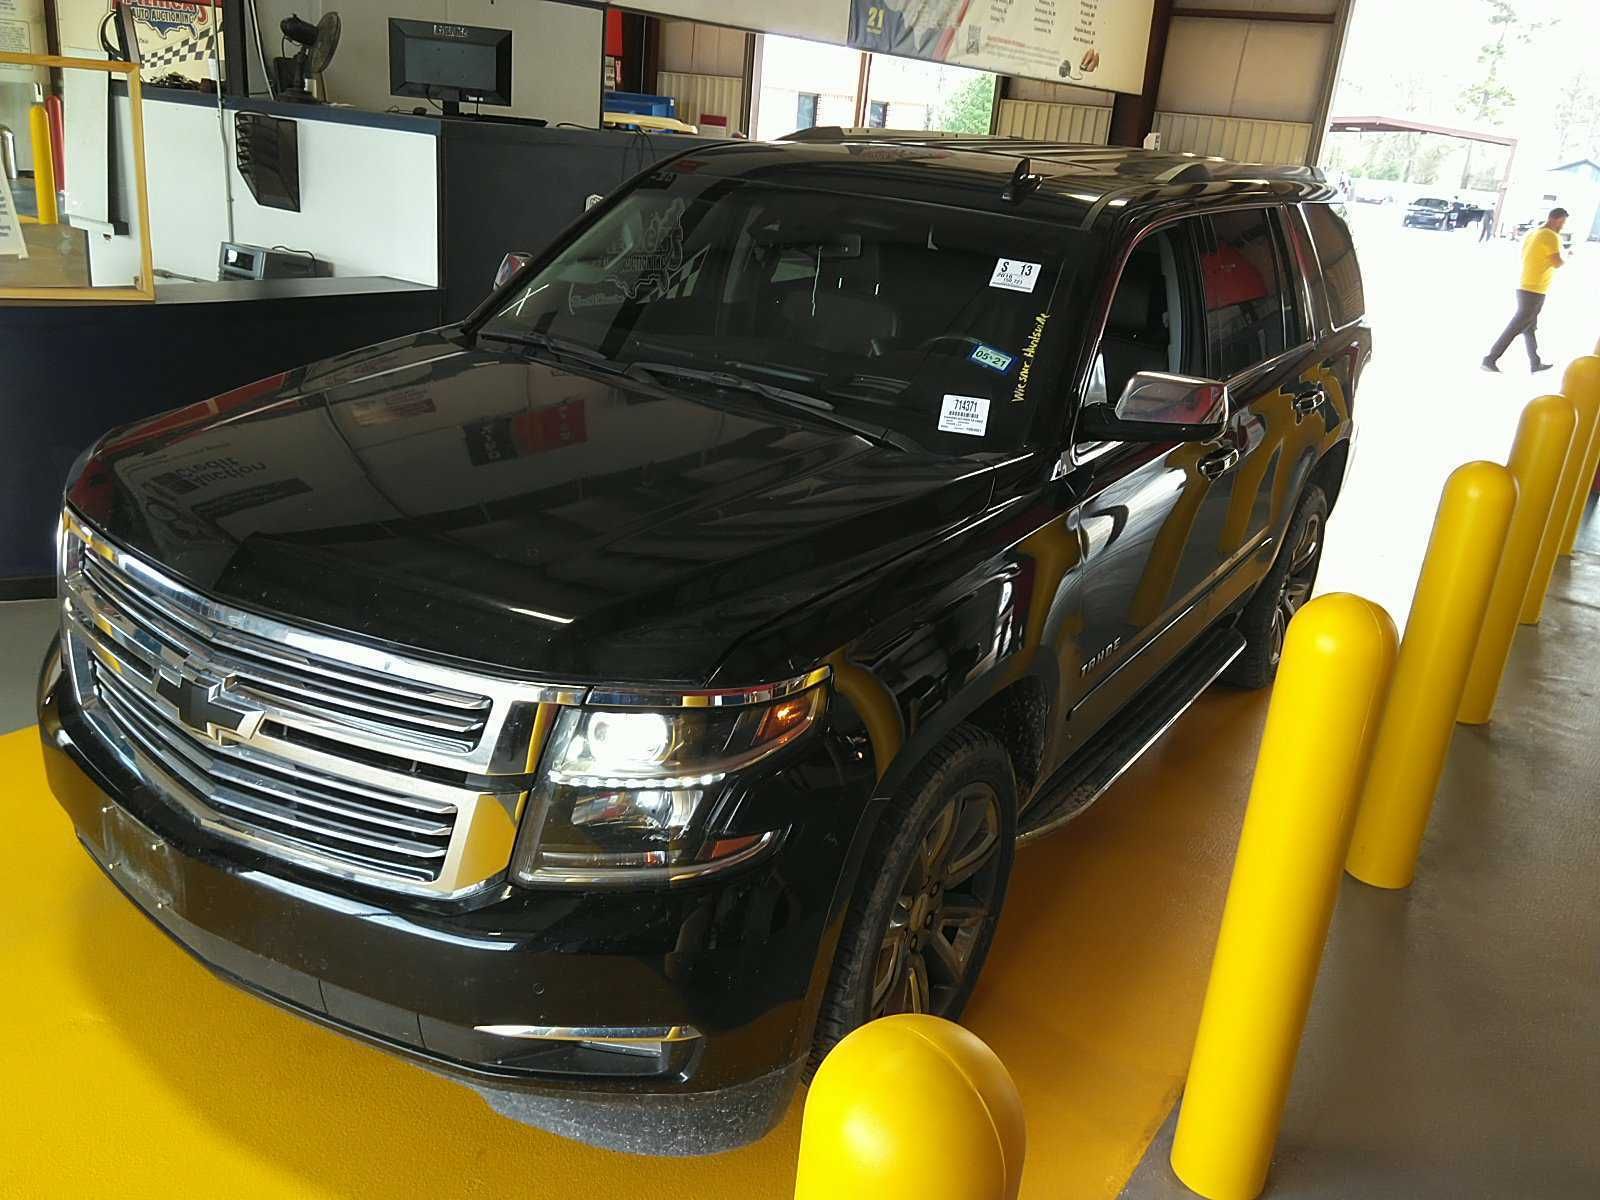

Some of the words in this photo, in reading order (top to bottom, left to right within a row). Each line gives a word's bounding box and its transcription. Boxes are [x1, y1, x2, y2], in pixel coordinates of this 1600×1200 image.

[151, 9, 179, 23] AUCTION
[867, 7, 884, 28] 21
[1001, 261, 1009, 272] S
[1020, 264, 1033, 276] 13
[975, 350, 990, 360] 05
[992, 357, 1006, 367] 21
[954, 399, 978, 413] 714371
[1081, 636, 1121, 679] TAHOE
